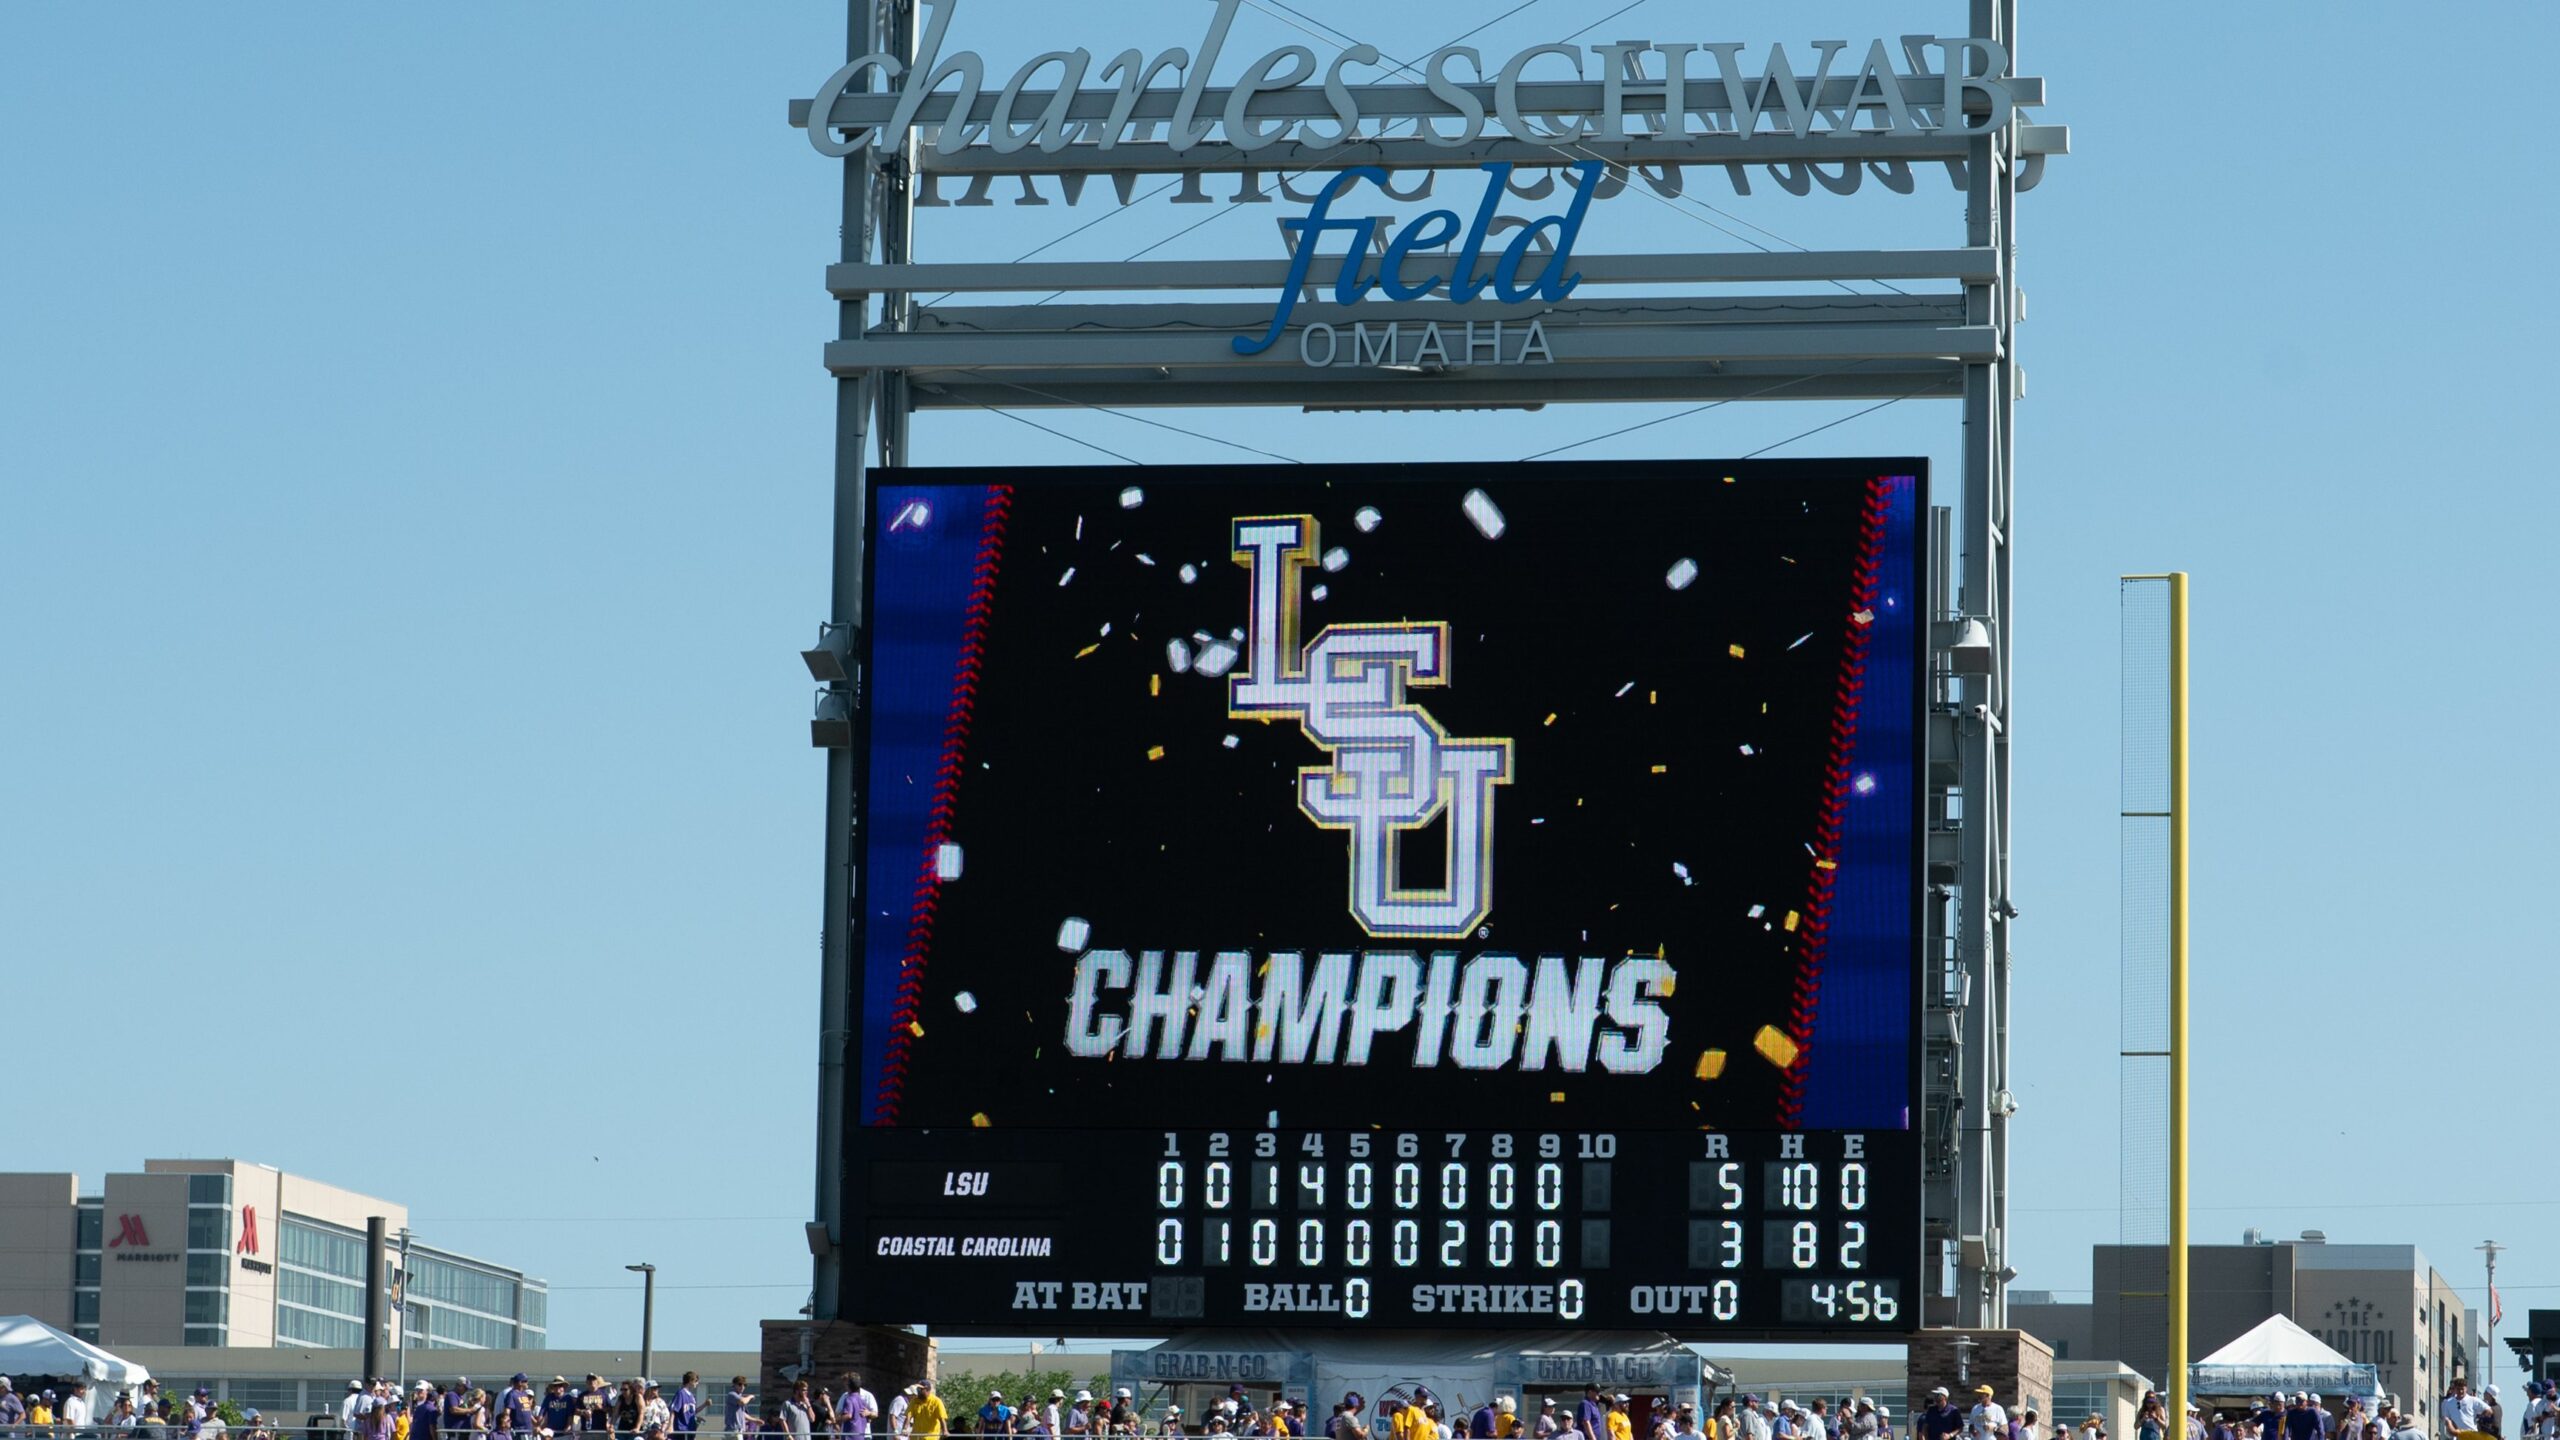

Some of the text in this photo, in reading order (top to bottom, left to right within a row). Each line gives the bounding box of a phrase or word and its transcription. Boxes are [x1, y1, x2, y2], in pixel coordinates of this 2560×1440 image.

[1422, 37, 2012, 148] SCHWAB
[1231, 160, 1604, 356] field
[1299, 320, 1555, 368] OMAHA
[1229, 514, 1515, 940] LSU
[1063, 948, 1677, 1075] CHAMPIONS
[1164, 1132, 1865, 1159] 1 2 3 4 5 6 7 8 9 10 R H E
[943, 1161, 1866, 1211] LSU 0 0 1 4 0 0 0 0 0 5 10 0
[876, 1218, 1865, 1269] COASTAL CAROLINA 0 1 0 0 0 0 2 0 0 3 8 2
[1012, 1281, 1148, 1310] AT BAT
[1243, 1278, 1370, 1319] BALL 0
[1412, 1279, 1584, 1320] STRIKE 0
[1630, 1280, 1738, 1321] OUT 0
[2340, 1311, 2369, 1327] THE
[1154, 1352, 1268, 1380] GRAB-N-GO
[1537, 1355, 1652, 1383] GRAB-N-GO
